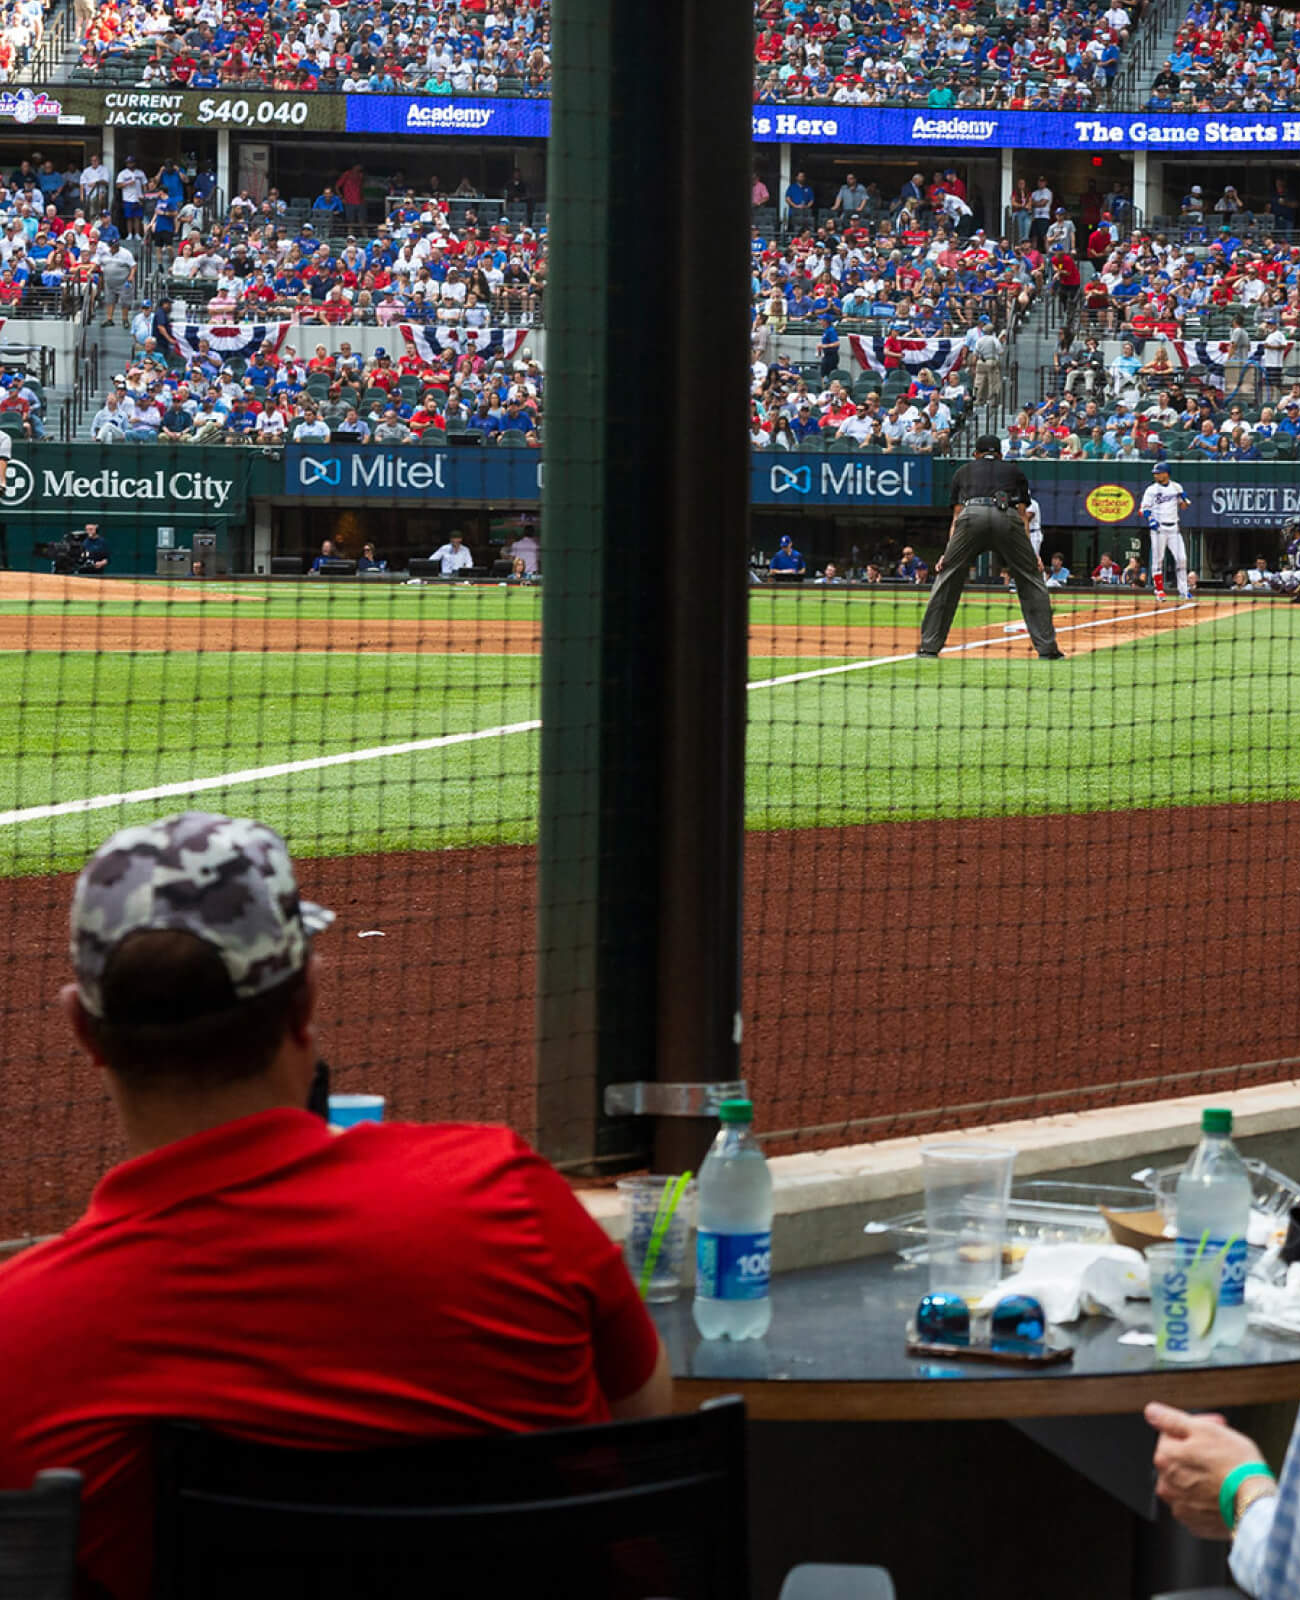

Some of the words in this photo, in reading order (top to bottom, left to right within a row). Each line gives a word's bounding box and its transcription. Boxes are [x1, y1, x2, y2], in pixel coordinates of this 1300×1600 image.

[105, 93, 183, 109] CURRENT
[197, 98, 308, 126] $40,040
[105, 111, 183, 126] JACKPOT
[407, 104, 491, 127] Academy
[775, 114, 838, 135] Here
[912, 116, 995, 139] Academy
[1075, 121, 1123, 142] The
[1129, 122, 1200, 142] Game
[1205, 122, 1278, 142] Starts
[352, 453, 445, 488] Mitel
[821, 462, 912, 496] Mitel
[43, 469, 165, 500] Medical
[170, 471, 233, 509] City
[1211, 488, 1278, 514] SWEET
[1164, 1272, 1189, 1353] ROCKS
